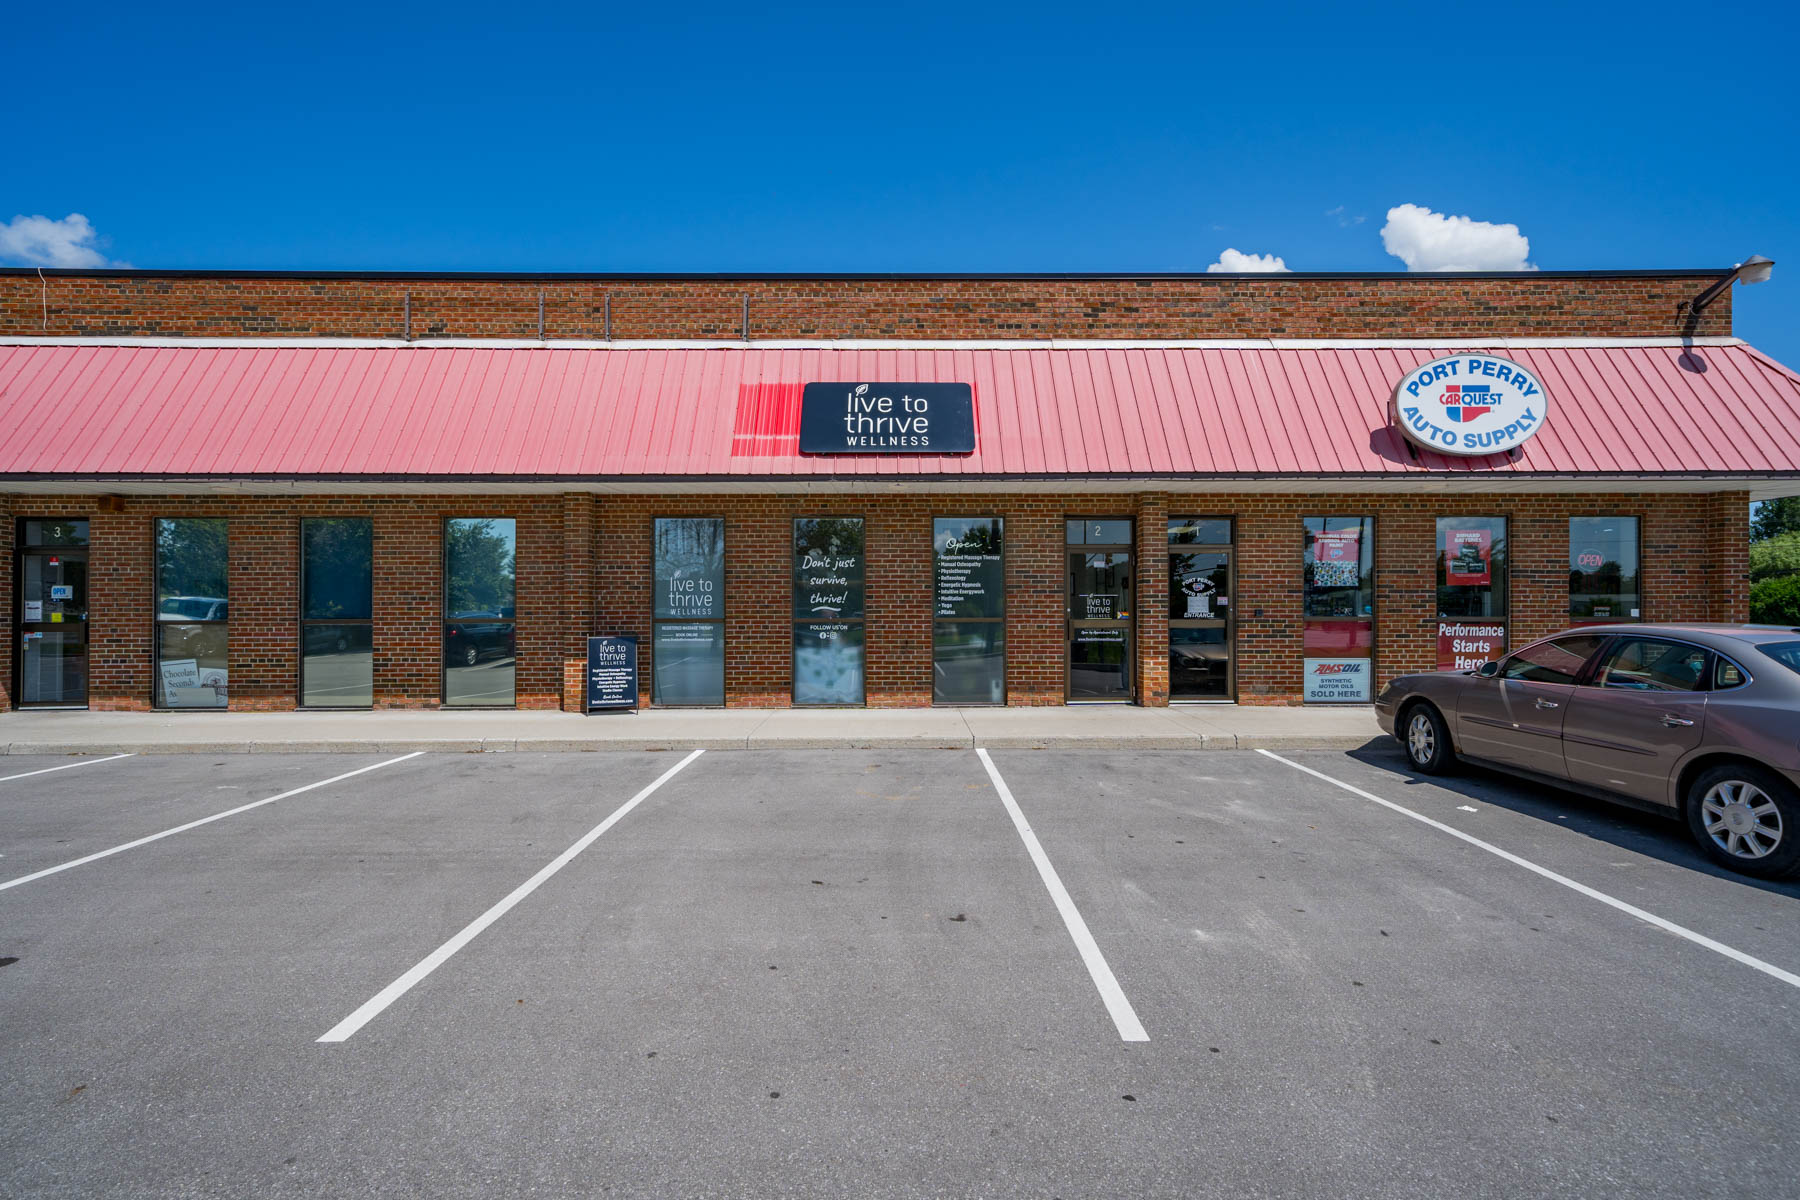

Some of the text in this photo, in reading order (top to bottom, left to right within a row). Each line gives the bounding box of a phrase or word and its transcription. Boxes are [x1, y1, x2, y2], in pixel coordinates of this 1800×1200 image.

[1406, 359, 1539, 397] PORT PERRY
[848, 392, 928, 413] live to
[1439, 393, 1503, 407] CARQUEST
[844, 413, 929, 433] thrive
[1403, 407, 1537, 448] AUTO SUPPLY
[847, 436, 929, 446] WELLNESS
[54, 527, 61, 538] 3
[1094, 526, 1101, 536] 2
[946, 537, 983, 555] Open
[802, 555, 856, 571] Don't just
[1578, 554, 1603, 567] OPEN
[670, 577, 713, 592] live to
[810, 575, 848, 587] survive,
[53, 587, 66, 595] OPEN
[668, 592, 713, 607] thrive
[810, 591, 848, 604] thrive!
[1086, 597, 1111, 606] live to
[670, 608, 712, 616] WELLNESS
[1086, 605, 1111, 614] thrive
[1438, 623, 1504, 637] Performance
[600, 644, 626, 653] live to
[1452, 639, 1490, 653] Starts
[599, 652, 626, 661] thrive
[163, 668, 197, 679] Chocolate
[1313, 664, 1361, 675] AMSOIL
[168, 678, 195, 688] Seconds
[1310, 690, 1362, 698] SOLD HERE
